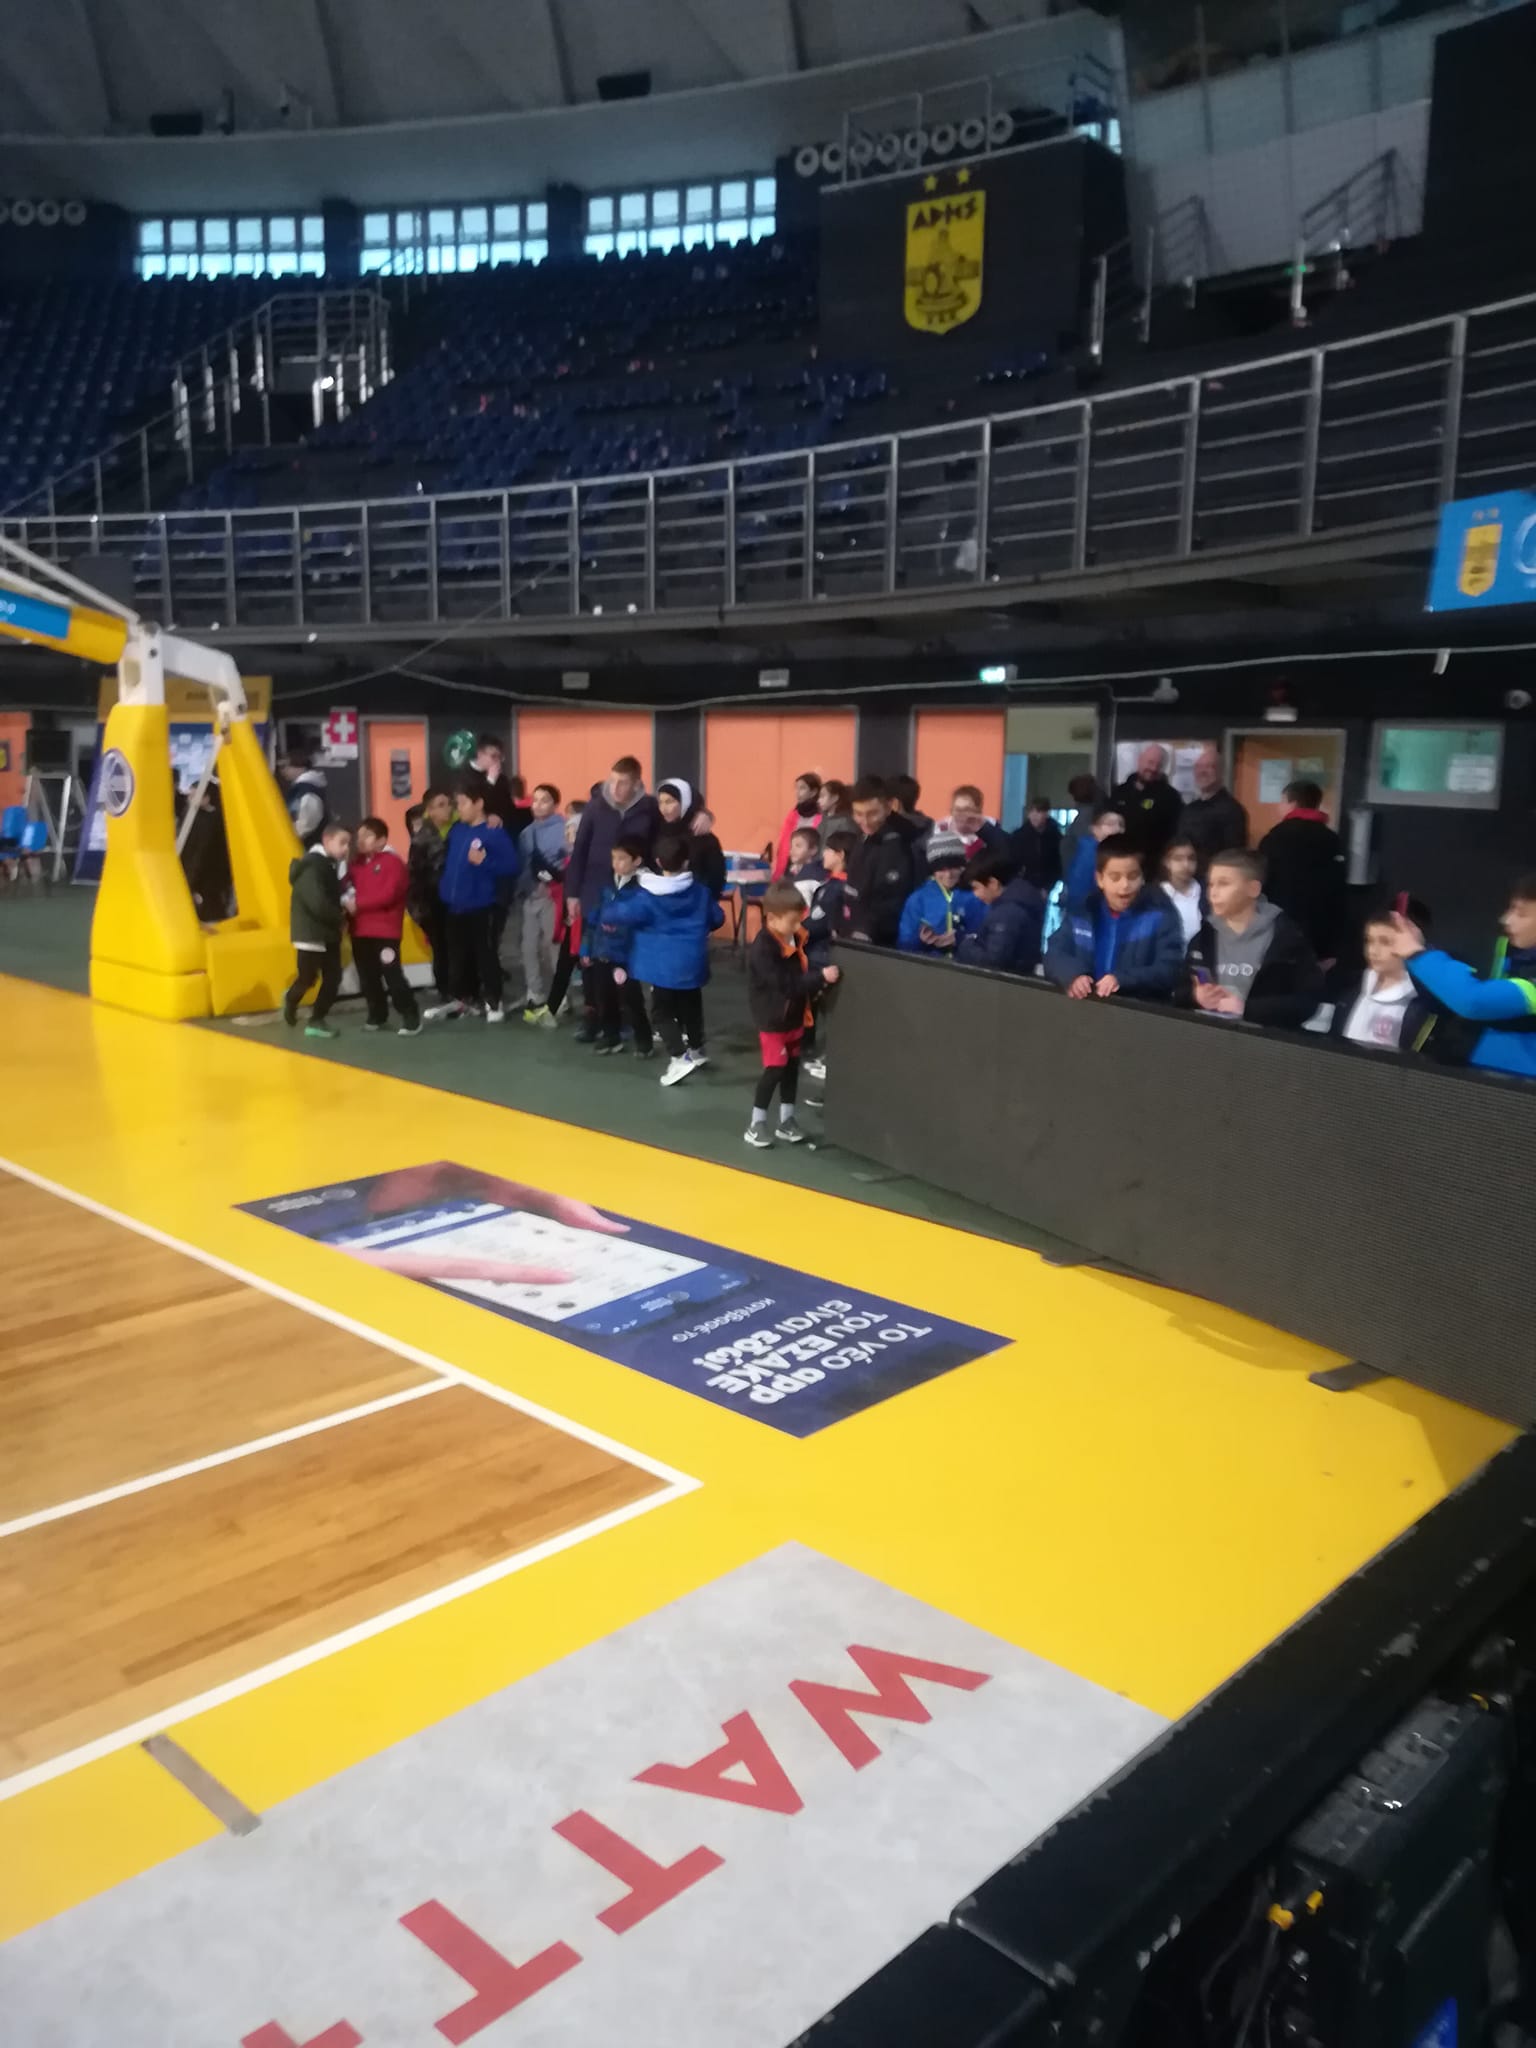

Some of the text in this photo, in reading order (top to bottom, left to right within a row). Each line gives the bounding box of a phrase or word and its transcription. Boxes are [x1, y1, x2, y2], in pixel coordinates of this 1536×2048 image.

[692, 1299, 853, 1372] είναι εδώ!
[705, 1311, 889, 1394] του ΕΣΑΚΕ
[820, 1341, 889, 1371] νέο
[749, 1367, 826, 1404] app
